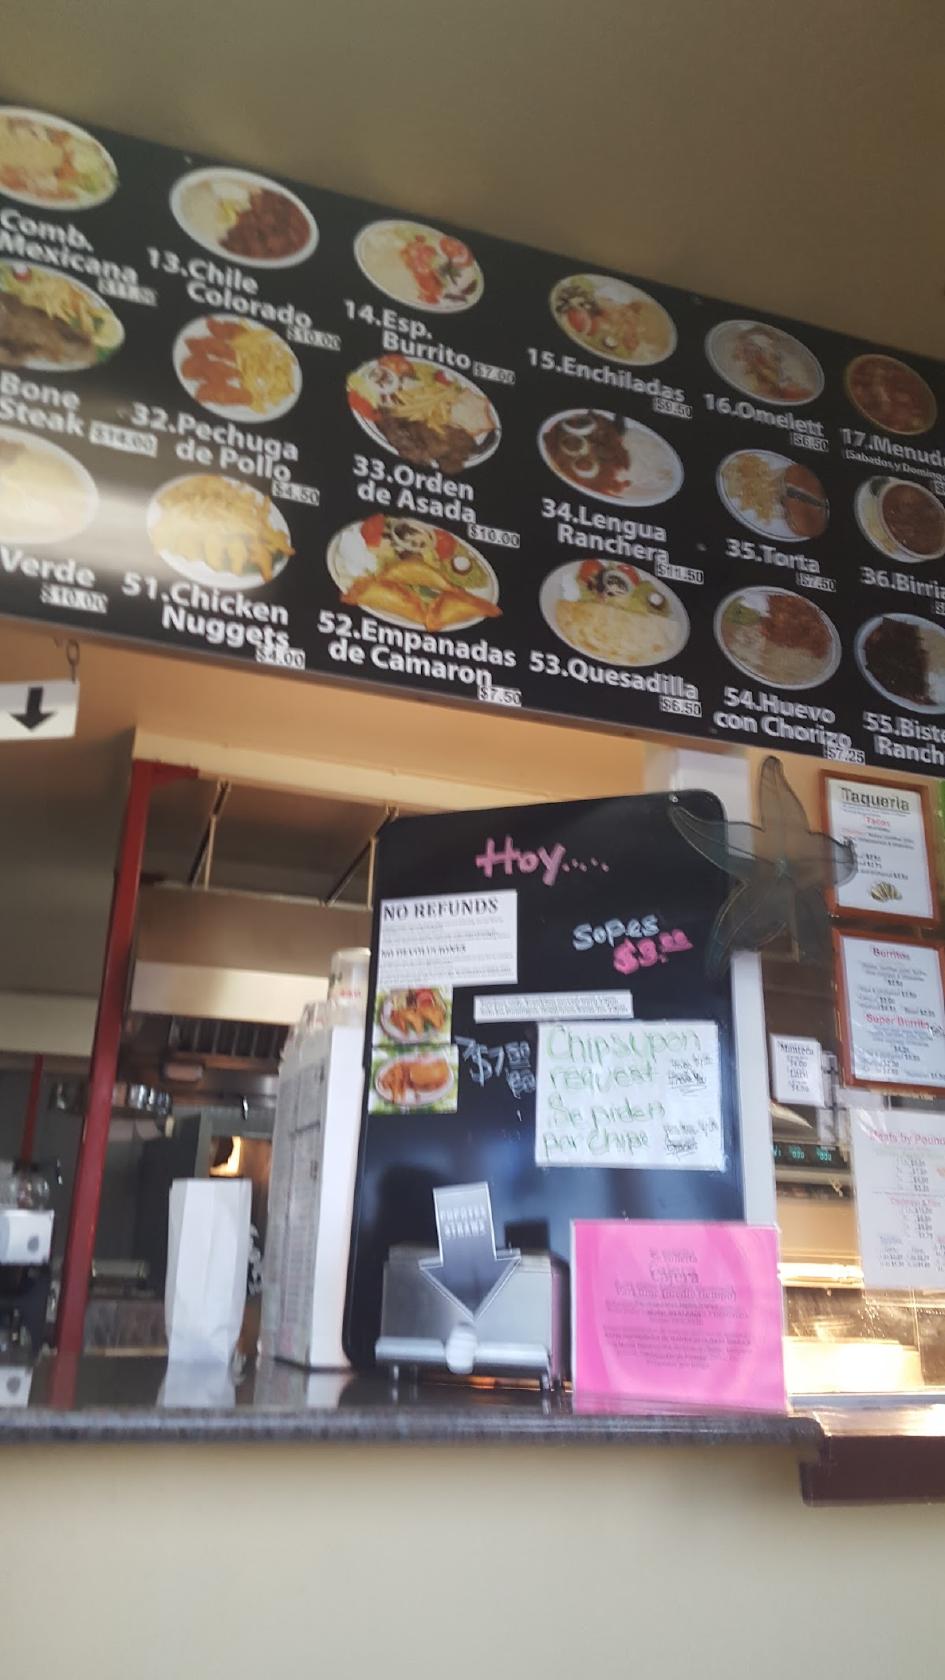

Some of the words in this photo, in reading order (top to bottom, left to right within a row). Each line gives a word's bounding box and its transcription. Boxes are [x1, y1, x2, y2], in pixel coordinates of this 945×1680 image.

[0, 209, 93, 251] Comb.
[0, 231, 139, 285] Mexicana
[147, 247, 259, 295] 13.Chile
[187, 282, 313, 328] Colorado
[344, 300, 433, 339] 14.Esp.
[382, 332, 472, 369] Burrito
[0, 371, 80, 413] Bone
[527, 348, 686, 402] 15.Enchiladas
[0, 399, 84, 437] Steak
[653, 399, 692, 419] $9.50
[703, 393, 825, 437] 16.Omelett
[131, 402, 299, 461] 32.Pechuga
[176, 440, 213, 466] de
[220, 449, 292, 484] Pollo
[353, 455, 474, 501] 33.Orden
[357, 481, 391, 505] de
[397, 491, 477, 523] Asada
[541, 498, 667, 542] 34.Lengua
[467, 523, 521, 548] $10.00
[557, 524, 669, 563] Ranchera
[725, 538, 820, 574] 35.Torta
[0, 545, 96, 587] Verde
[655, 561, 704, 584] $11.50
[122, 572, 289, 625] 51.Chicken
[161, 605, 290, 649] Nuggets
[317, 610, 517, 668] 52.Empanadas
[256, 645, 305, 669] $4.00
[328, 638, 365, 664] de
[371, 647, 493, 687] Camaron
[529, 650, 699, 700] 53.Quesadilla
[478, 686, 522, 707] $7.50
[660, 695, 702, 718] $6.50
[724, 686, 836, 724] 54.Huevo
[713, 711, 758, 734] con
[760, 713, 852, 749] Chorizo
[825, 745, 865, 764] $7.25
[841, 786, 911, 811] Taqueria
[383, 904, 409, 921] NO
[413, 898, 499, 919] REFUNDS
